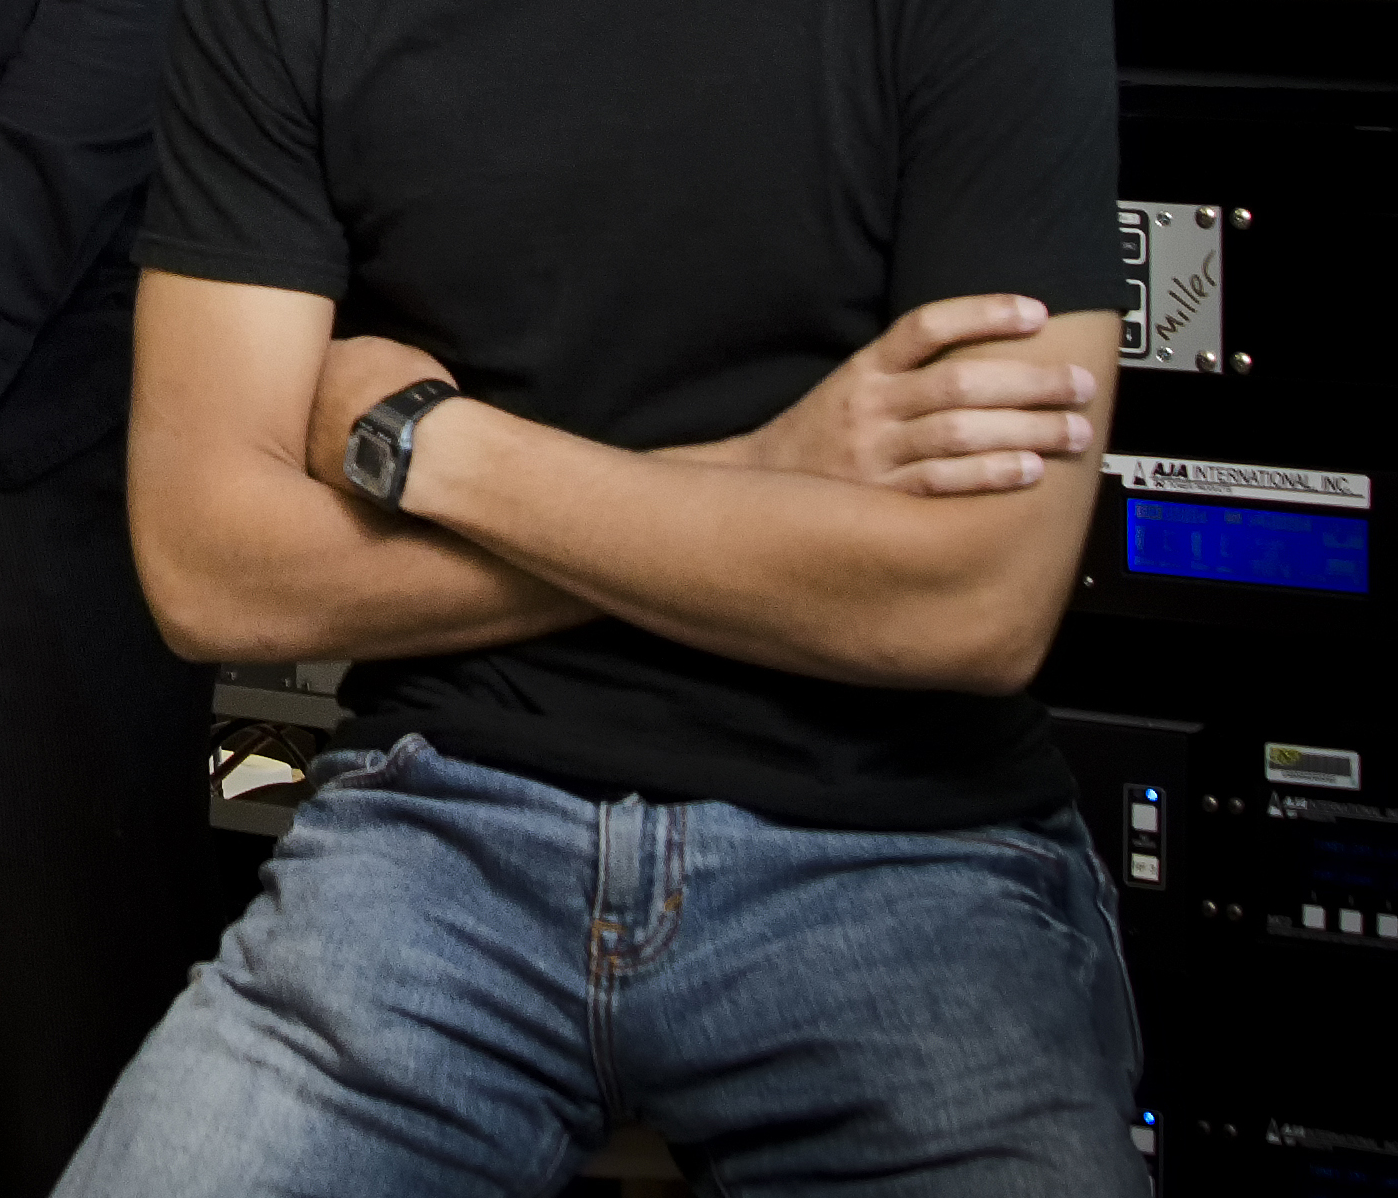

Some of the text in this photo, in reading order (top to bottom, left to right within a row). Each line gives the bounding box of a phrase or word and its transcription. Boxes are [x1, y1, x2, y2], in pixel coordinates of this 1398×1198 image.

[1156, 249, 1217, 341] Miller
[1152, 462, 1188, 479] AJA
[1191, 464, 1310, 490] INTERNATIONAL
